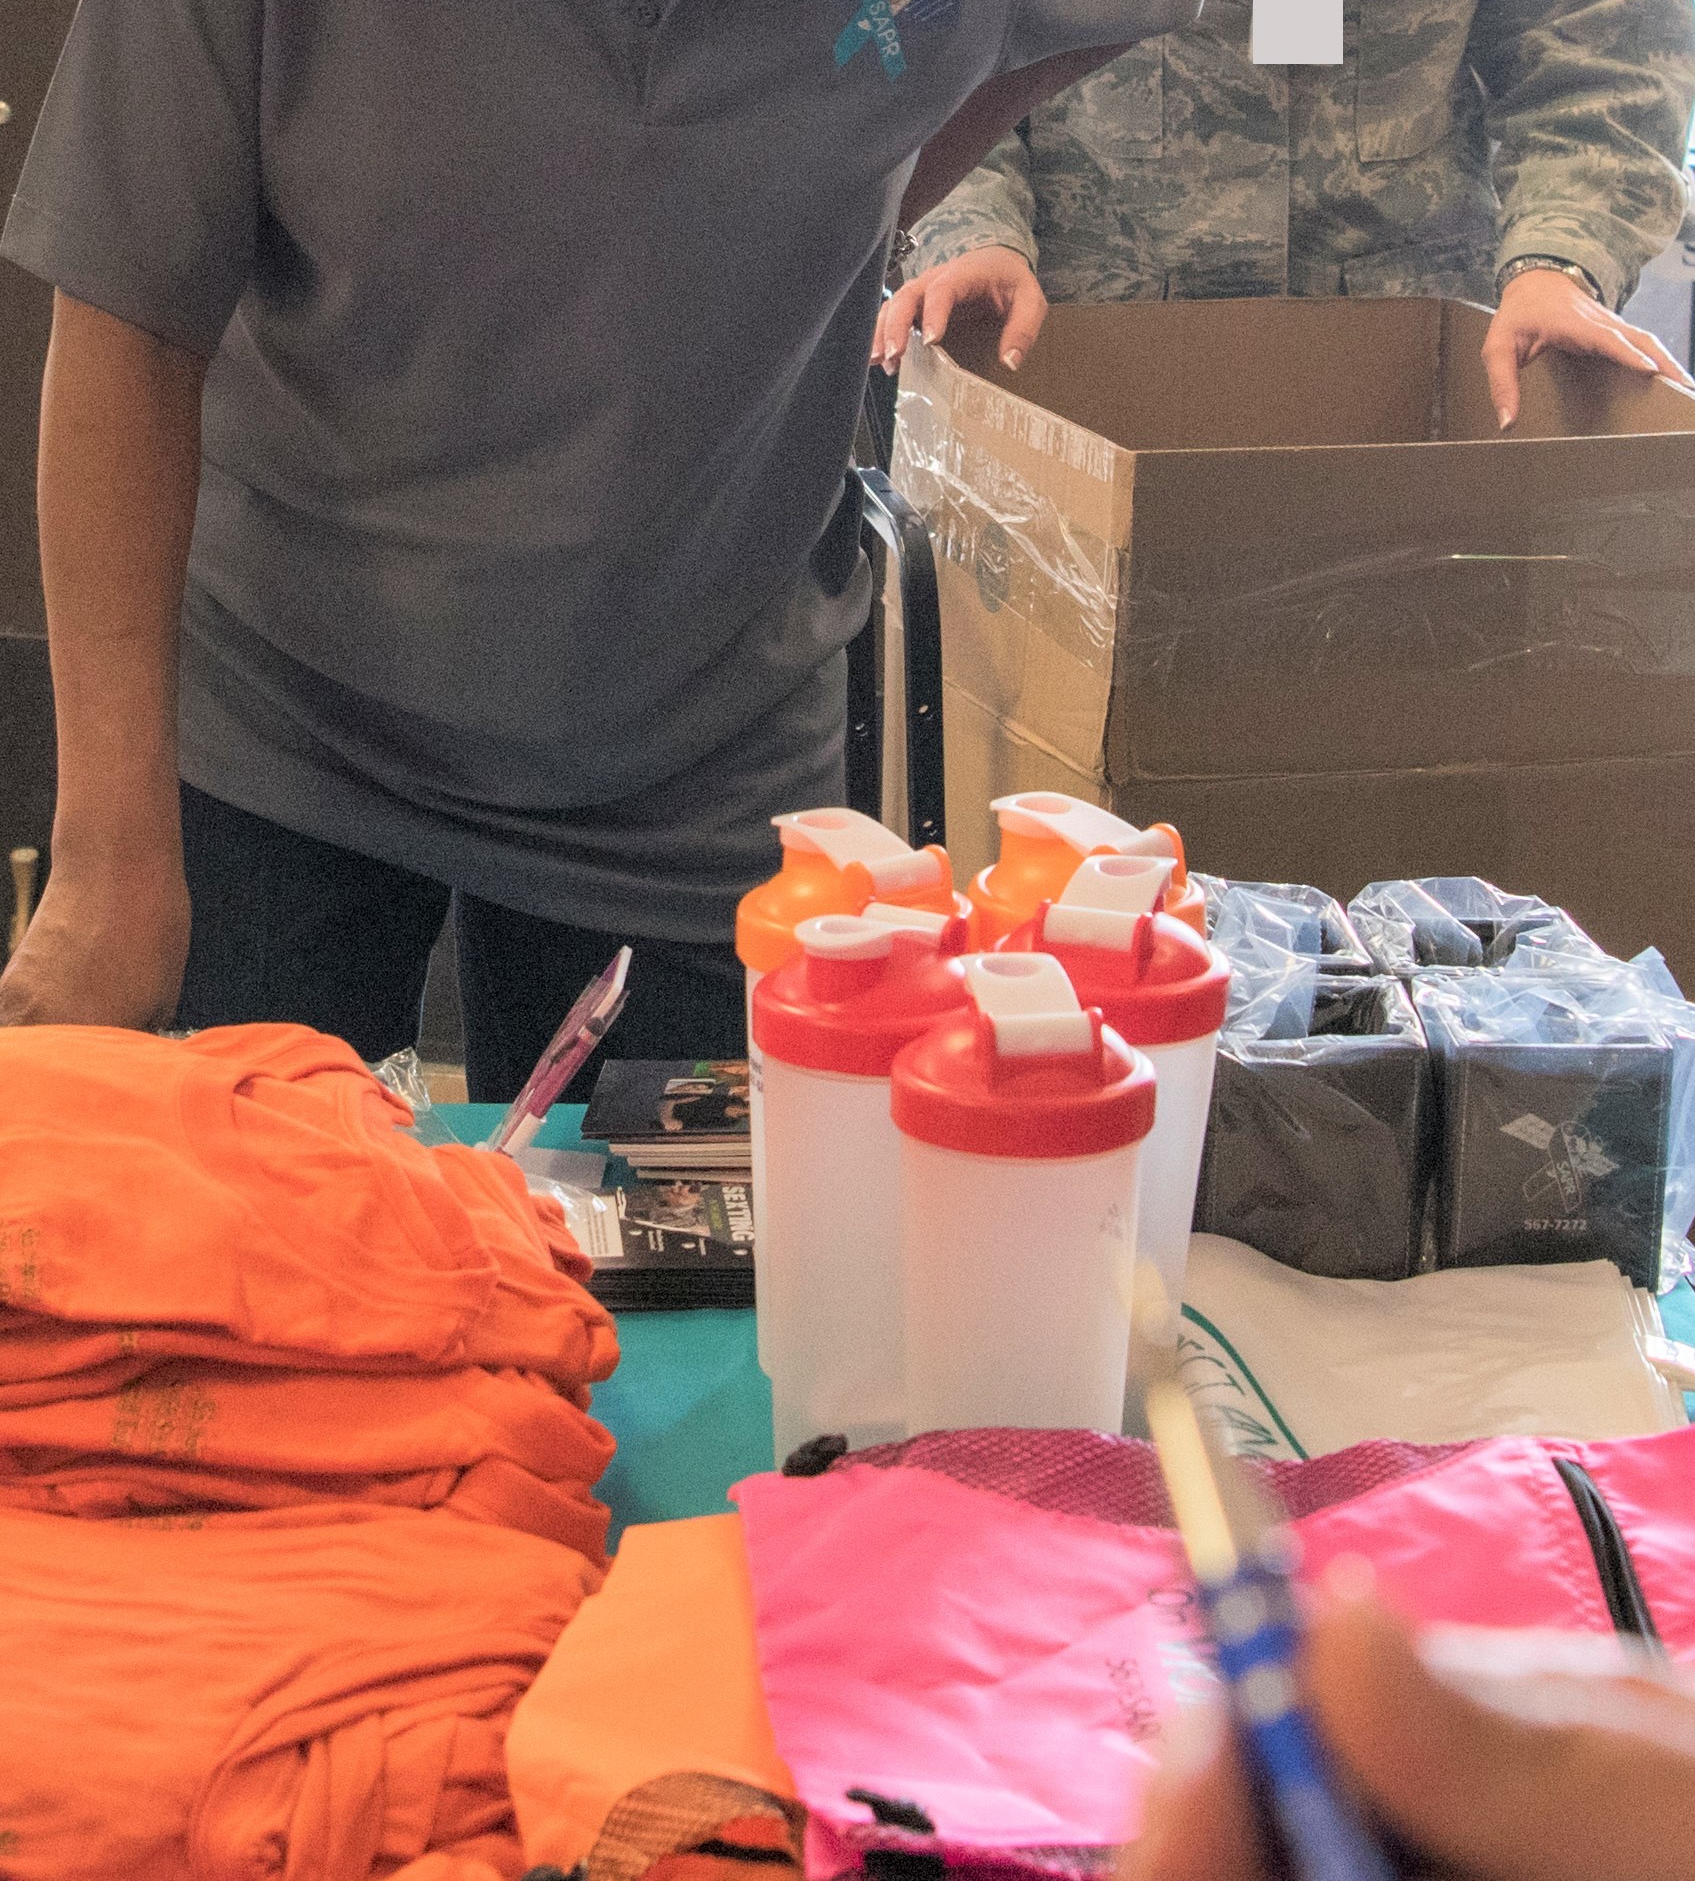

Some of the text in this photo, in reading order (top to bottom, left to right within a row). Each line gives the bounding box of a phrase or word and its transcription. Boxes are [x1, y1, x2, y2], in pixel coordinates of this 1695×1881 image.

[869, 1, 900, 58] SAPR
[1556, 1161, 1576, 1195] SAPR
[722, 1186, 754, 1242] SEXTING
[1524, 1219, 1587, 1231] 567-7272
